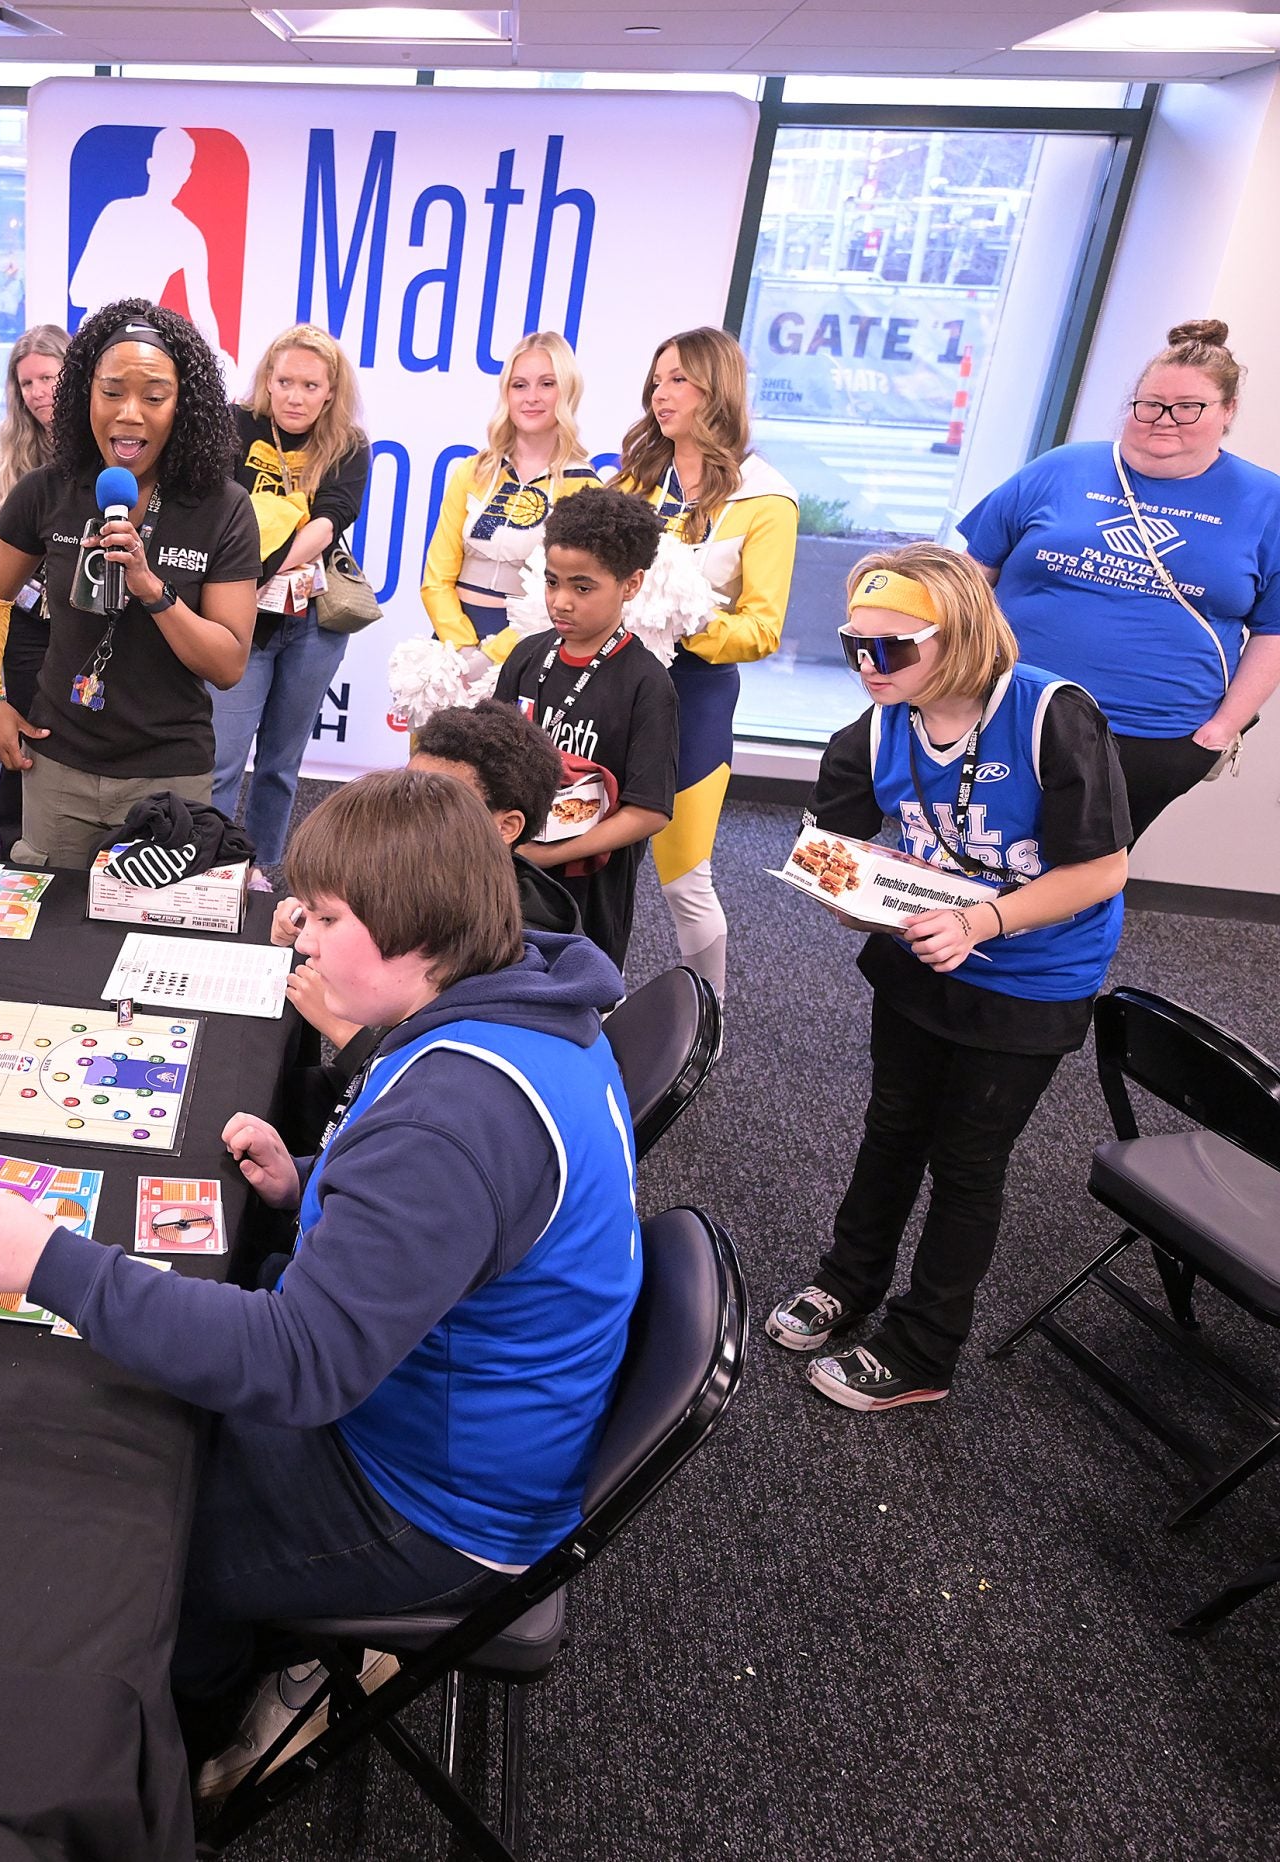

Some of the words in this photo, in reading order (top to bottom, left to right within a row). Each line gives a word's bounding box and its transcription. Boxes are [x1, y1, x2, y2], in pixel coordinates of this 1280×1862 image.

[296, 128, 597, 375] Math
[768, 311, 919, 362] GATE
[937, 319, 965, 364] 1
[761, 378, 793, 391] SHIEL
[759, 390, 803, 403] SEXTON
[1085, 491, 1117, 504] GREAT
[1160, 506, 1193, 519] START
[1194, 512, 1223, 525] HERE.
[52, 532, 79, 545] Coach
[157, 556, 207, 573] FRESH
[159, 546, 208, 562] LEARN
[1035, 549, 1080, 568] BOYS
[1081, 560, 1095, 573] &
[1098, 565, 1148, 587] GIRLS
[1047, 564, 1062, 573] OF
[1063, 568, 1136, 591] HUNTINGTON
[873, 873, 909, 892] Franchise
[908, 883, 955, 905] Opportunities
[881, 895, 898, 910] Visit
